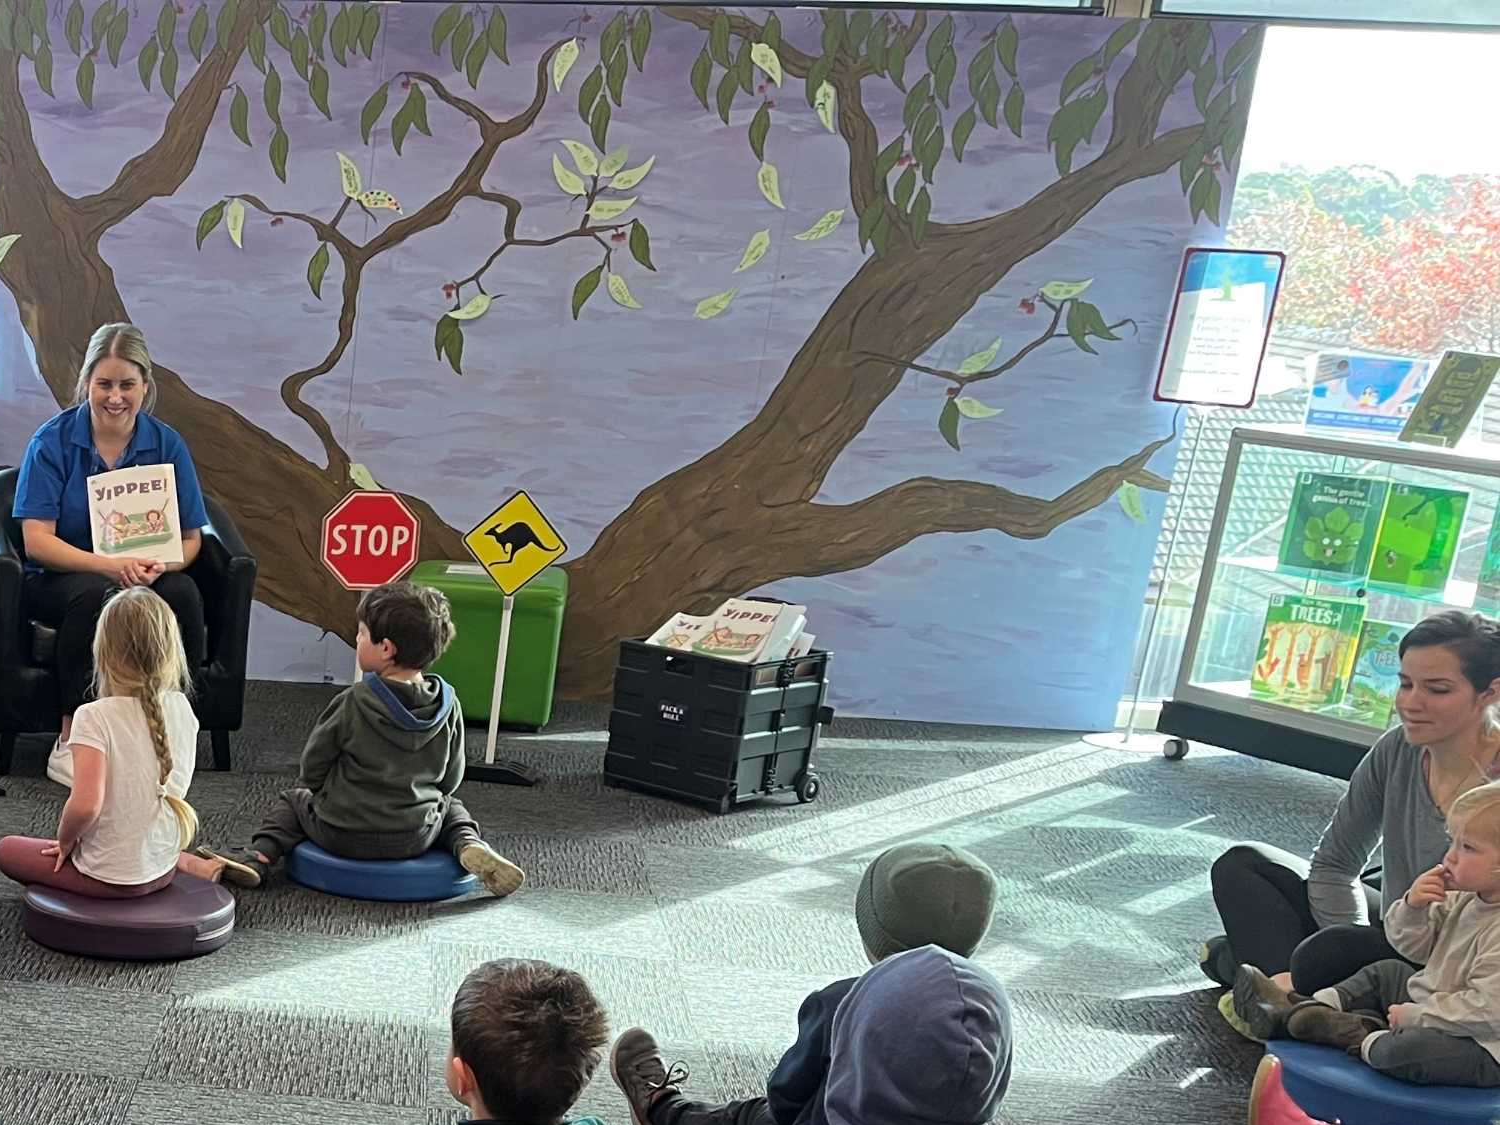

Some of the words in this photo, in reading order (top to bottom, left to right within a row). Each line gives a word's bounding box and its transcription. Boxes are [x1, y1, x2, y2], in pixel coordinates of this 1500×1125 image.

[95, 479, 167, 501] YIPPEE!
[330, 524, 410, 557] STOP
[1291, 604, 1342, 626] TREES?
[661, 704, 677, 714] PACK
